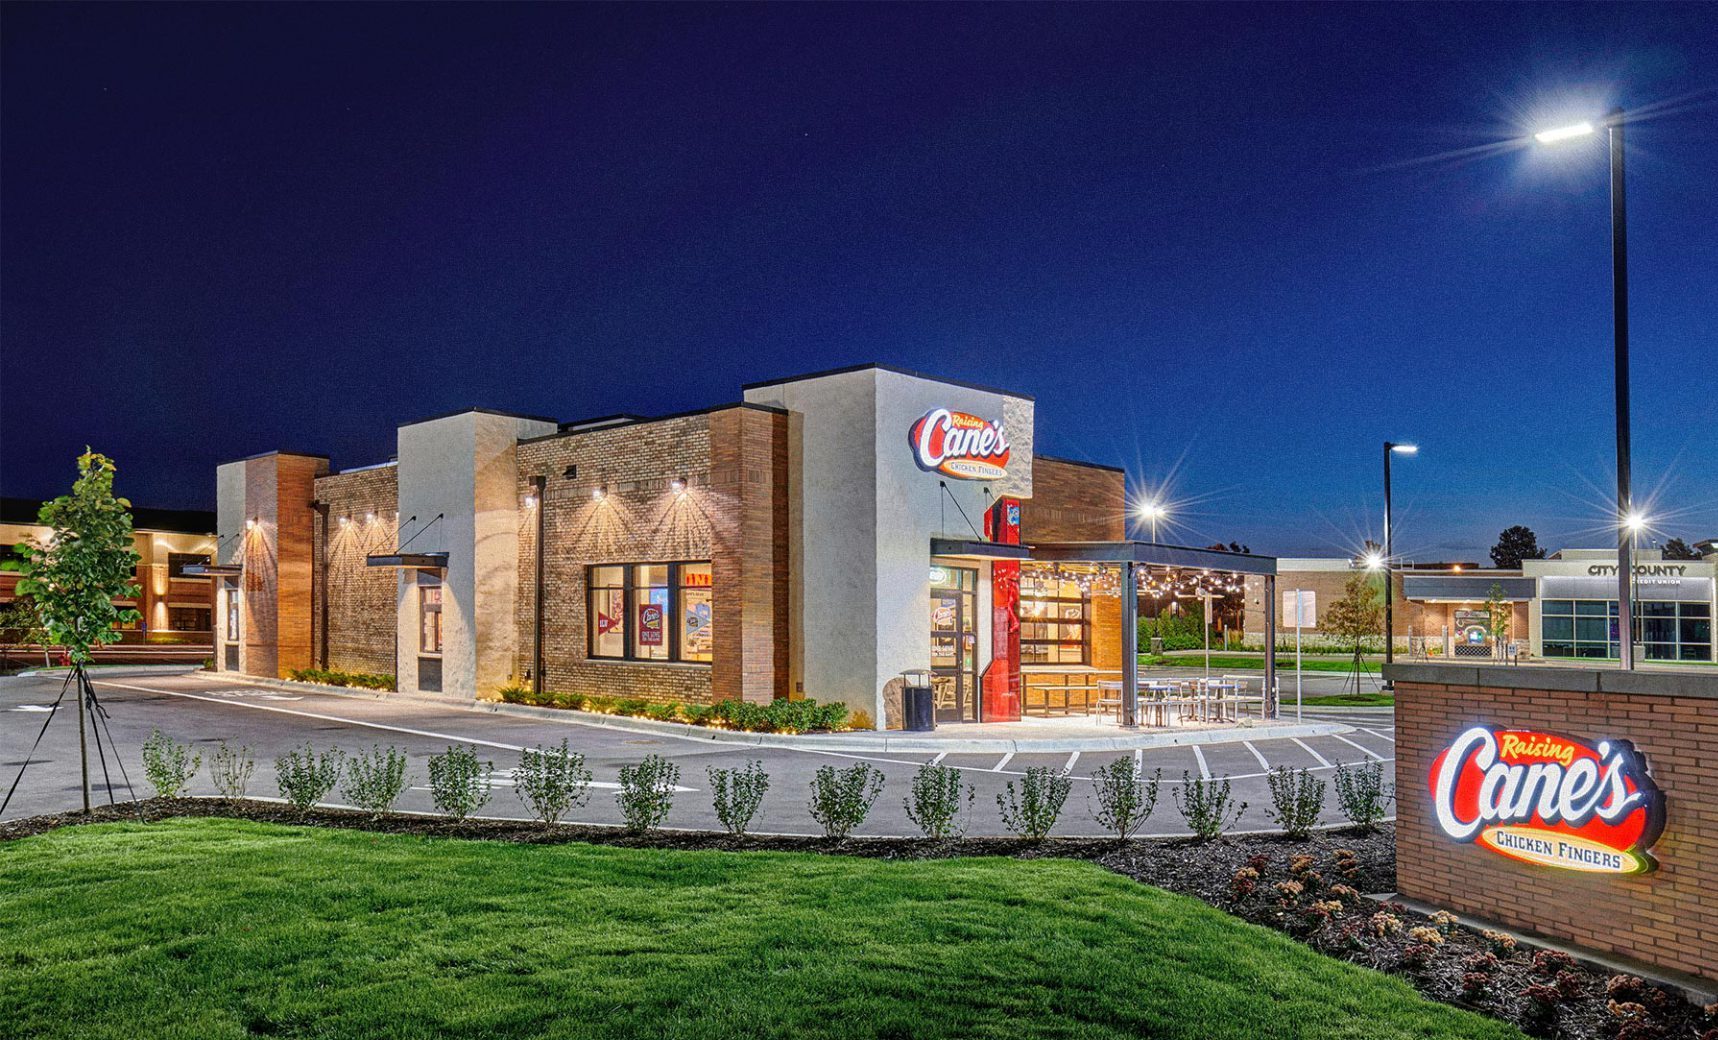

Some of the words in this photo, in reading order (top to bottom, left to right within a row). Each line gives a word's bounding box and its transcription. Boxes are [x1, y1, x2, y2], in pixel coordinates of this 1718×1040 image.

[921, 409, 1010, 466] Cane's
[952, 415, 984, 430] Raising
[1588, 565, 1619, 576] CITY
[1500, 734, 1576, 765] Raising
[1435, 727, 1642, 838] Cane's
[1496, 830, 1553, 855] CHICKEN
[1558, 841, 1622, 869] FINGERS
